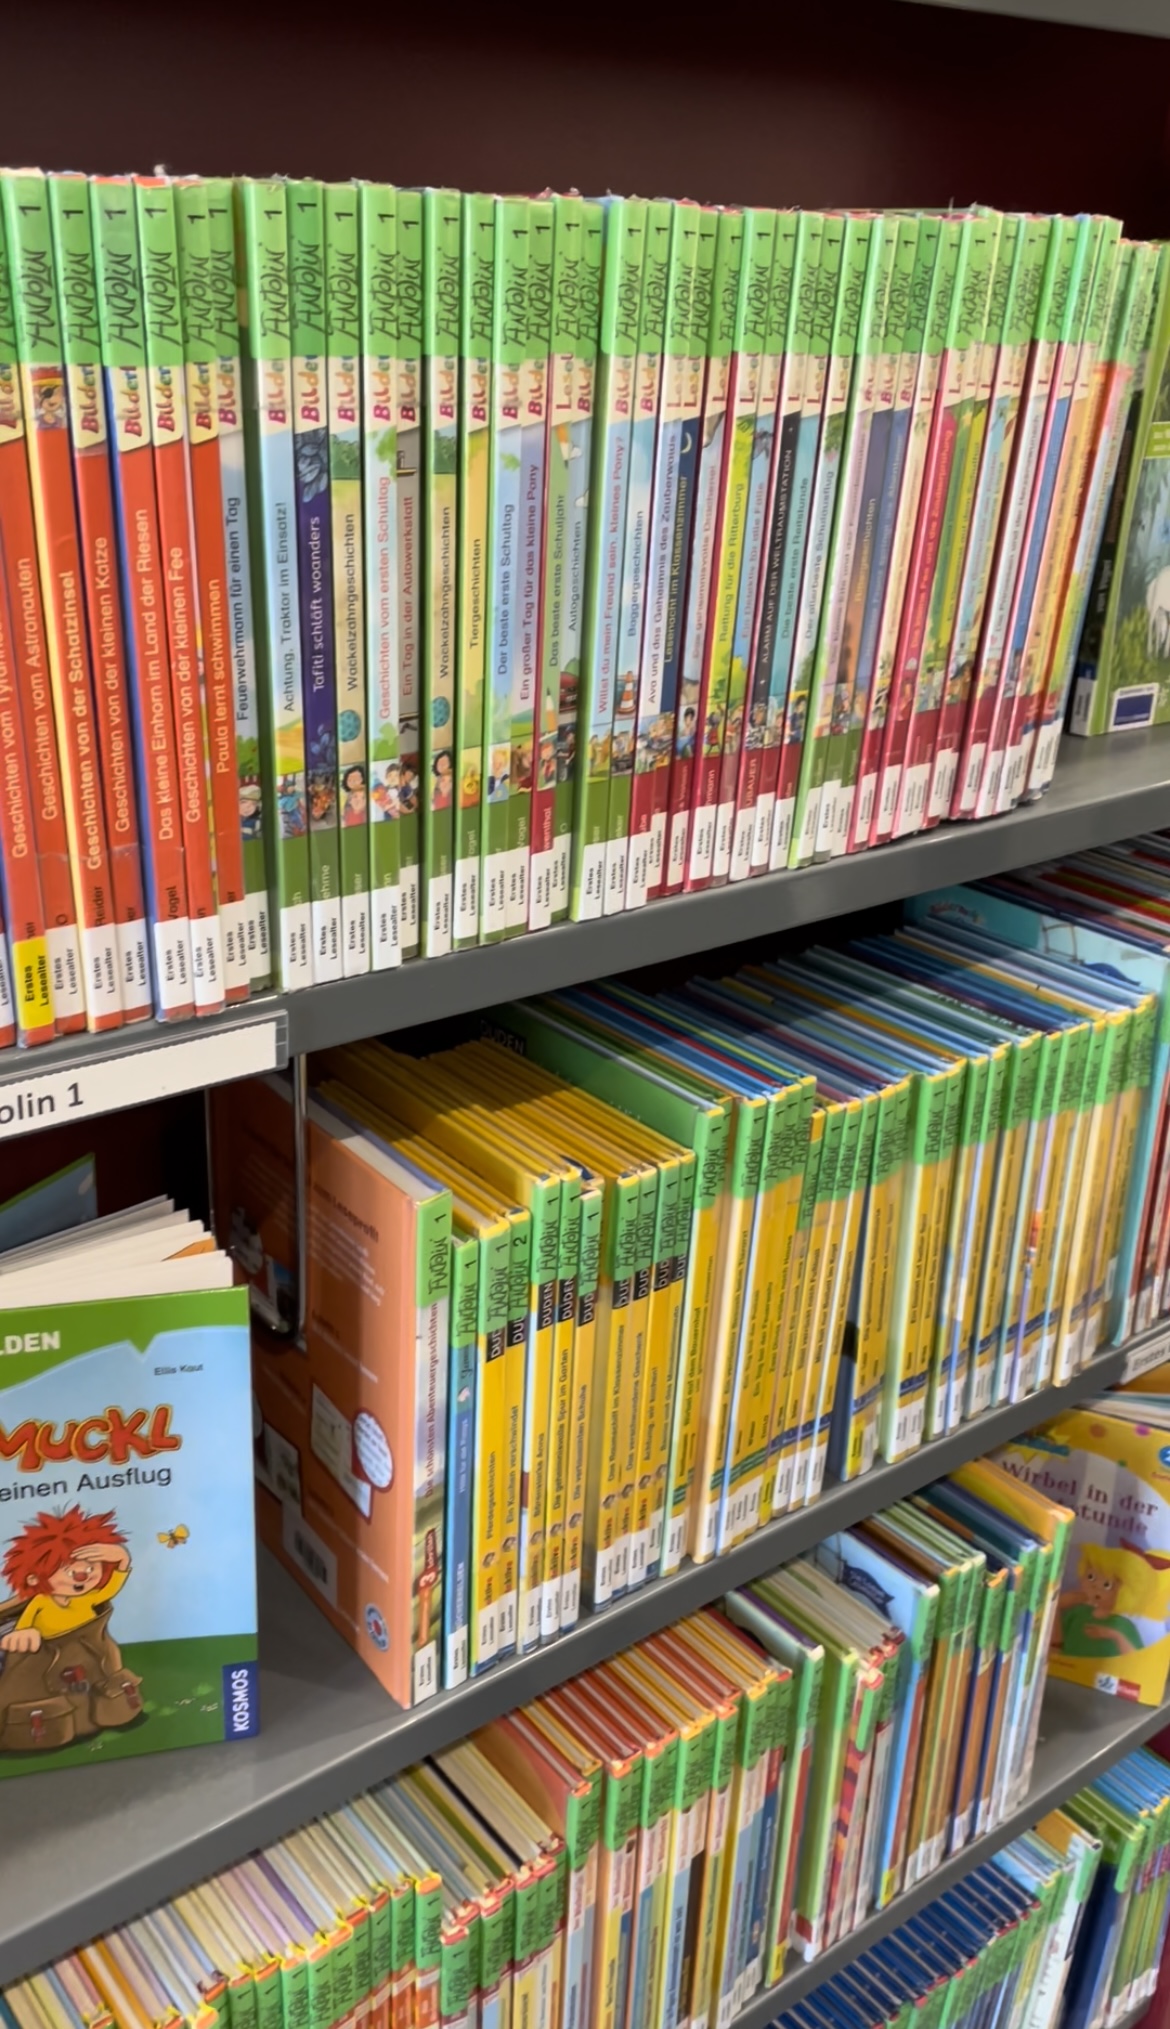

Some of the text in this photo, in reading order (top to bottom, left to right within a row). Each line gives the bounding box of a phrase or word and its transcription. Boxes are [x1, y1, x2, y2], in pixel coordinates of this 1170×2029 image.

[19, 205, 41, 216] 1
[297, 202, 317, 212] 1
[378, 213, 395, 223] 1
[609, 485, 621, 534] kleines
[569, 520, 582, 632] Autogeschichten
[627, 510, 645, 637] Baggergeschichten
[647, 435, 677, 704] Ava und das Geheimnis des Zauberwalds
[664, 475, 688, 663] Lesenacht im Klassenzimmer
[719, 483, 745, 642] Rettung für die Ritterburg
[762, 449, 793, 664] ALARM AUF DER WELTRAUMSTATION
[781, 477, 809, 639] Die beste erste Reitstunde
[804, 471, 835, 639] Der allerbeste Schulausflug
[308, 516, 326, 692] Tafiti schläft woanders
[343, 513, 359, 691] Wackelzahngeschichten
[377, 476, 391, 719] Geschichten vom ersten Schultag
[402, 496, 415, 696] Ein Tag in der Autowerkstatt
[439, 506, 452, 679] Wackelzahngeschichten
[469, 538, 482, 649] Tiergeschichten
[497, 503, 514, 675] Der beste erste Schultag
[520, 464, 540, 700] Ein großer Tag für das kleine Pony
[548, 494, 566, 667] Das beste erste Schuljahr
[603, 572, 616, 619] Freund
[225, 497, 249, 721] Feuerwehrmann für einen Tag
[275, 502, 295, 712] Achtung, Traktor im Einsatz!
[601, 623, 612, 654] mein
[16, 558, 58, 820] Geschichten vom Astronauten
[94, 537, 130, 832] Geschichten von der kleinen Katze
[135, 509, 174, 840] Das kleine Einhorn im Land der Riesen
[168, 547, 201, 822] Geschichten von der kleinen Fee
[207, 579, 231, 773] Paula lernt schwimmen
[600, 658, 611, 674] du
[59, 570, 102, 870] Geschichten von der Schatzinsel
[598, 677, 609, 714] Willst
[0, 710, 15, 748] vom
[5, 752, 29, 858] Geschichten
[288, 931, 298, 963] Erstes
[298, 922, 308, 967] Lesealter
[319, 925, 328, 956] Erstes
[328, 917, 339, 960] Lesealter
[378, 912, 388, 943] Erstes
[389, 904, 399, 947] Lesealter
[22, 965, 35, 1002] Erstes
[36, 954, 50, 1006] Lesealter
[52, 957, 64, 990] Erstes
[64, 947, 78, 995] Lesealter
[91, 957, 103, 990] Erstes
[102, 946, 116, 994] Lesealter
[164, 949, 176, 982] Erstes
[175, 939, 188, 985] Lesealter
[194, 946, 205, 979] Erstes
[205, 936, 218, 983] Lesealter
[68, 1082, 84, 1108] 1
[434, 1214, 446, 1224] 1
[514, 1236, 527, 1245] 2
[542, 1281, 553, 1325] DUDEN
[0, 1331, 61, 1356] DEN
[180, 1364, 203, 1372] Kaut
[426, 1303, 439, 1423] Abenteuergeschichten
[426, 1425, 434, 1477] schönsten
[0, 1465, 172, 1502] einen Ausflug
[1002, 1461, 1158, 1516] Wirbel in der
[232, 1668, 249, 1732] KOSMOS
